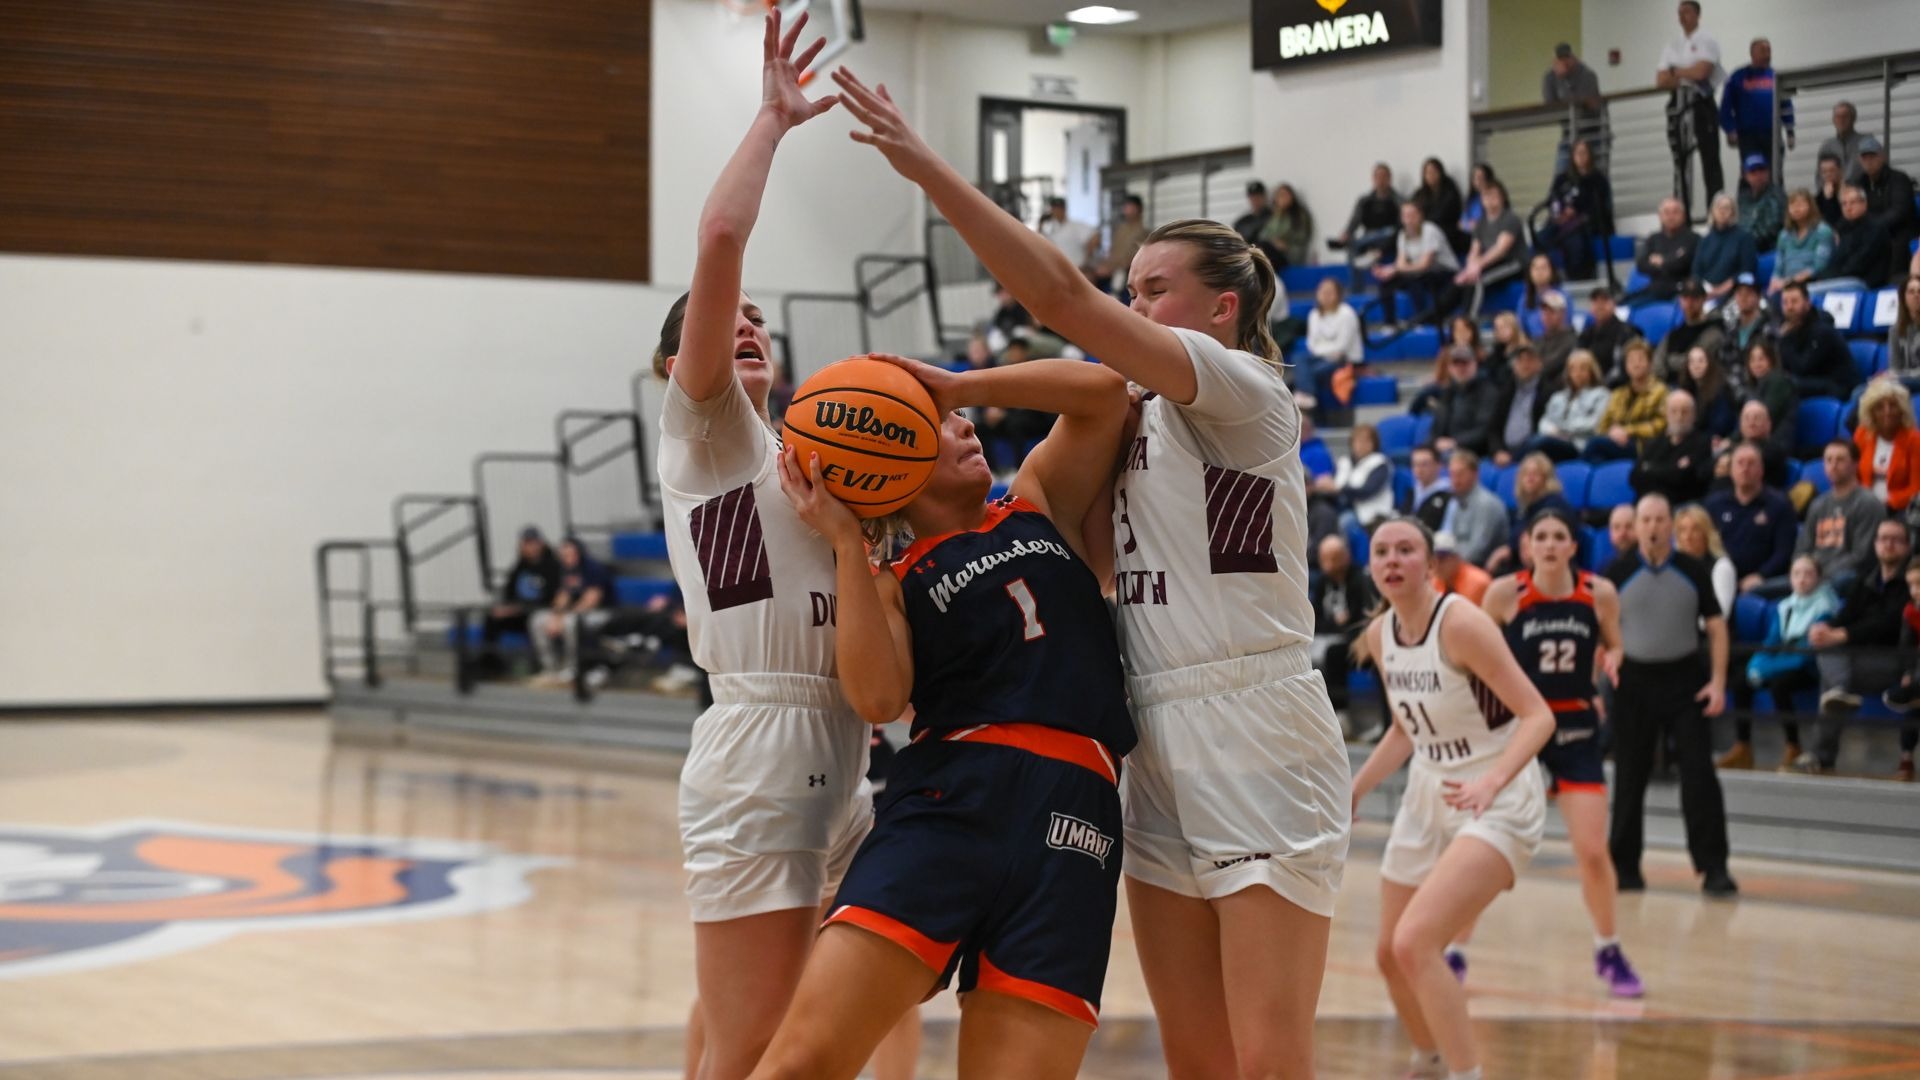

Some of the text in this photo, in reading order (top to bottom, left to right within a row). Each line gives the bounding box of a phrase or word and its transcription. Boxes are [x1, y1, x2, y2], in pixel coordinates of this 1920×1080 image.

[1279, 11, 1389, 58] BRAVERA
[815, 401, 917, 449] Wilson
[822, 463, 889, 491] EVO
[1004, 577, 1046, 642] 1
[1539, 640, 1576, 673] 22
[1399, 701, 1437, 735] 31
